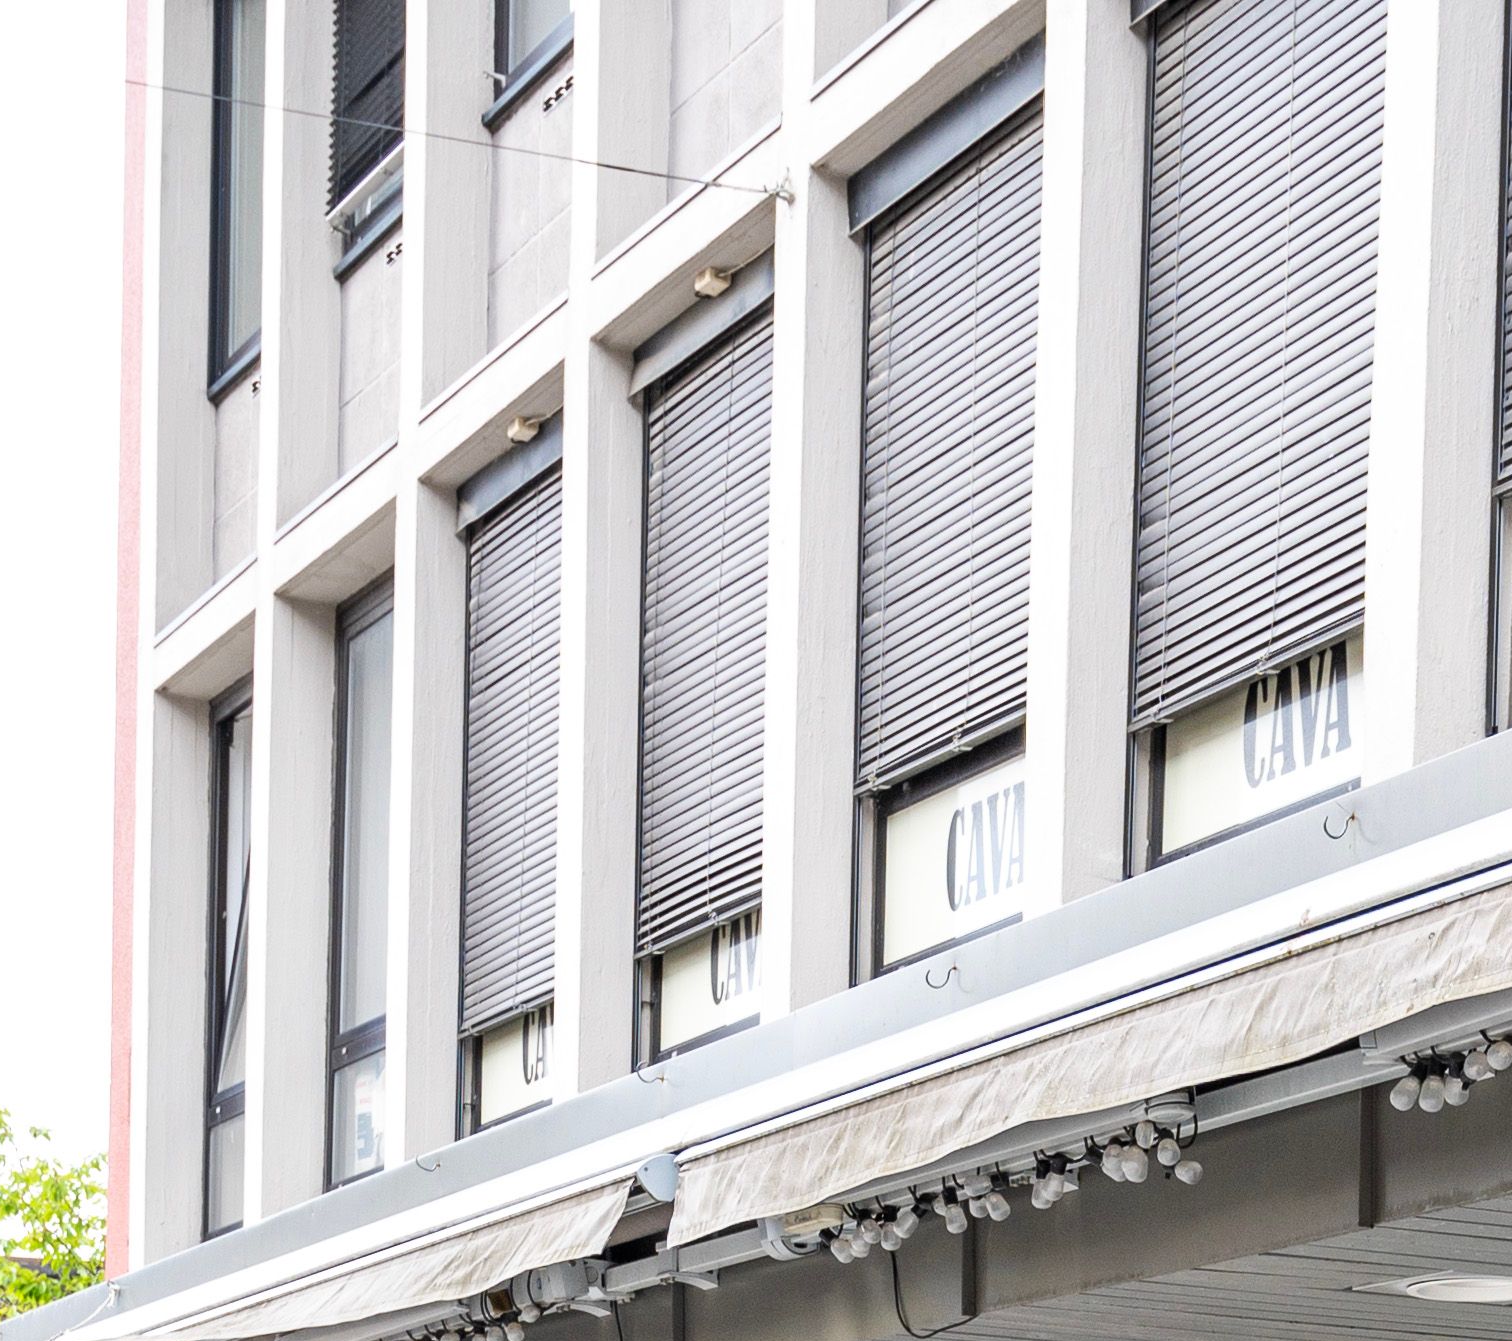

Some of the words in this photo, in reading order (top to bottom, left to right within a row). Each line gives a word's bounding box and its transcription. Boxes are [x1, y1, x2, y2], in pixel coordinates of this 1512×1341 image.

[1243, 640, 1351, 789] CAVA
[946, 780, 1024, 912] CAVA
[710, 908, 761, 1005] CAV
